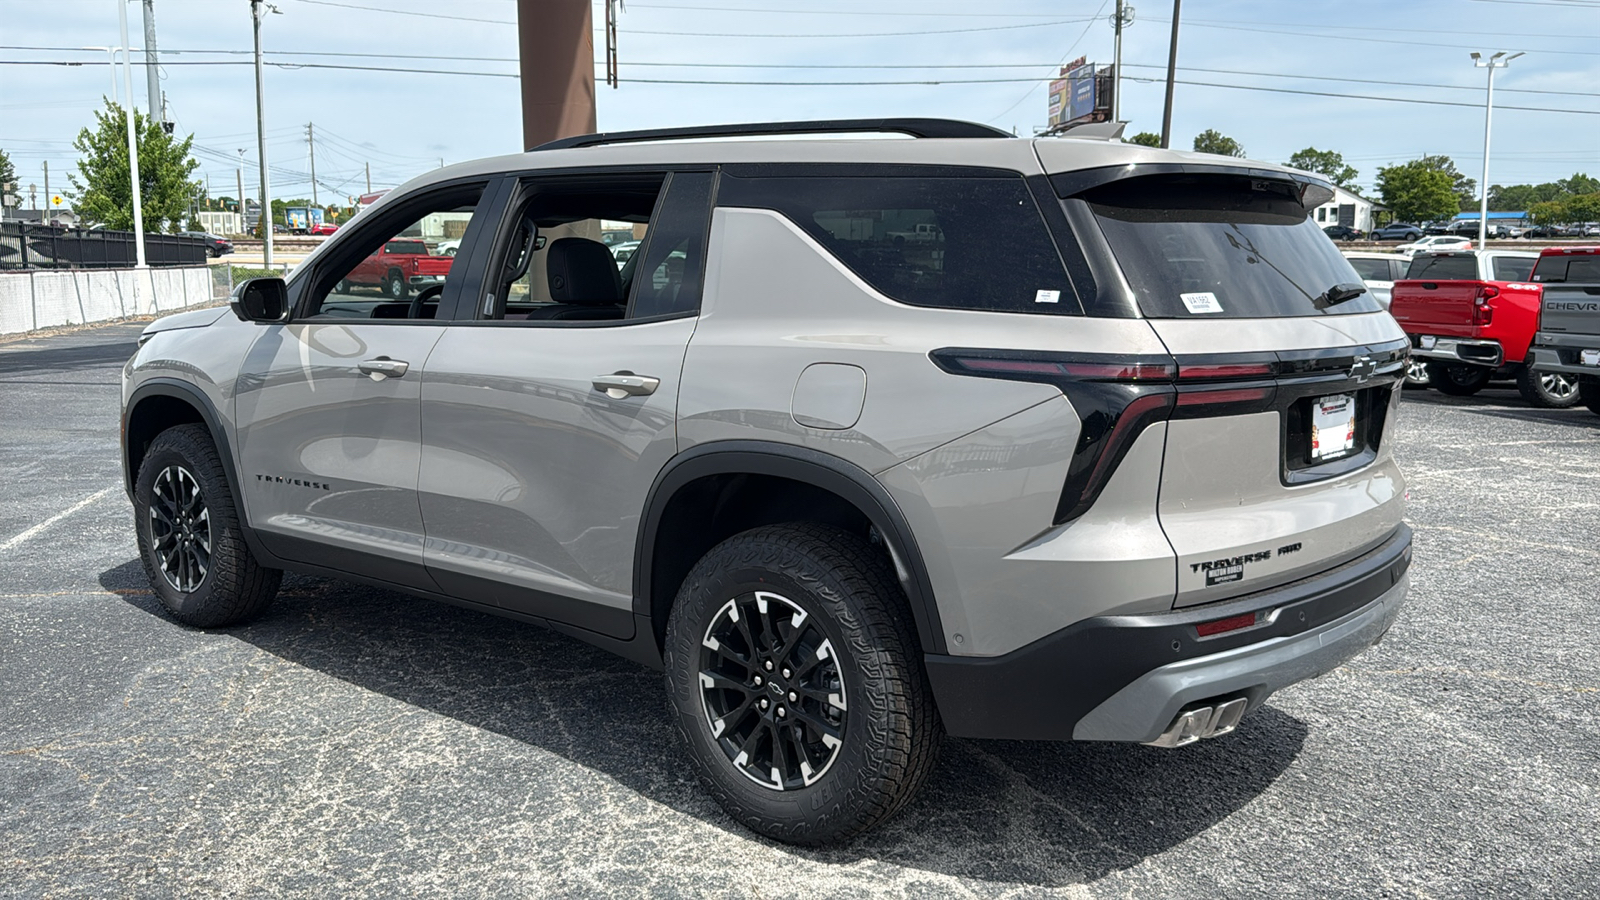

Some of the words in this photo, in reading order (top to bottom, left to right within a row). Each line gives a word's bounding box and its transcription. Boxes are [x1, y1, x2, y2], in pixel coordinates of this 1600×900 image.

[1546, 302, 1600, 311] CHEVR
[255, 474, 331, 490] TRAVERSE
[1190, 550, 1271, 573] TRAVERSE
